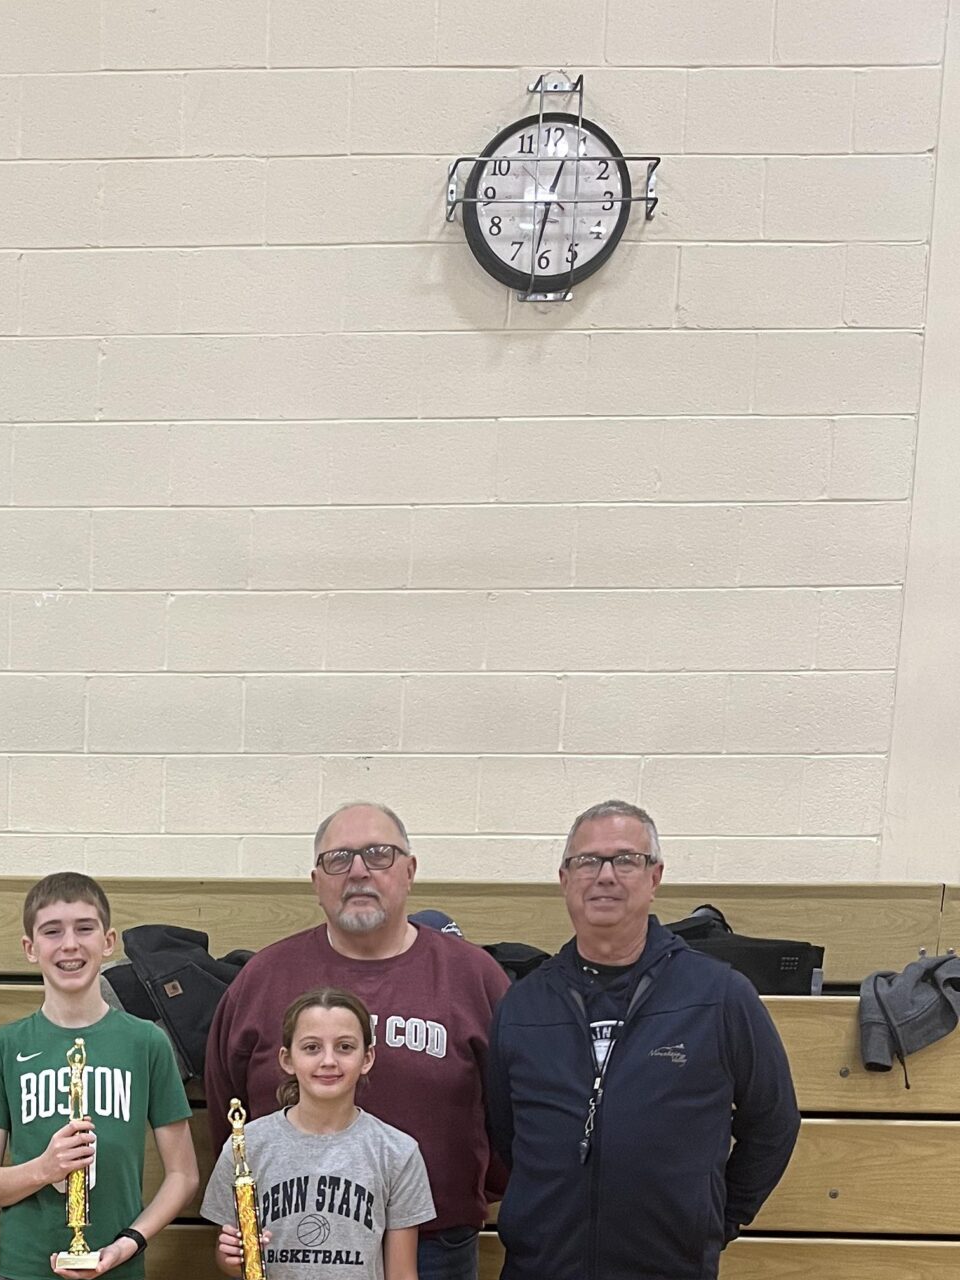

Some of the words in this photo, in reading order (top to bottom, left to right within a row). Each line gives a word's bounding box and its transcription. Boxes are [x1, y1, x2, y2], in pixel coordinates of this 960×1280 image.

[518, 134, 535, 154] 11
[544, 127, 565, 149] 12
[491, 156, 511, 176] 10
[596, 161, 610, 181] 2
[483, 186, 497, 207] 9
[602, 191, 614, 211] 3
[488, 215, 502, 236] 8
[589, 219, 602, 240] 4
[510, 241, 524, 261] 7
[537, 249, 551, 269] 6
[565, 243, 579, 264] 5
[385, 1015, 447, 1059] COD
[20, 1066, 132, 1125] BOSTON
[261, 1175, 310, 1229] PENN
[315, 1175, 375, 1231] STATE
